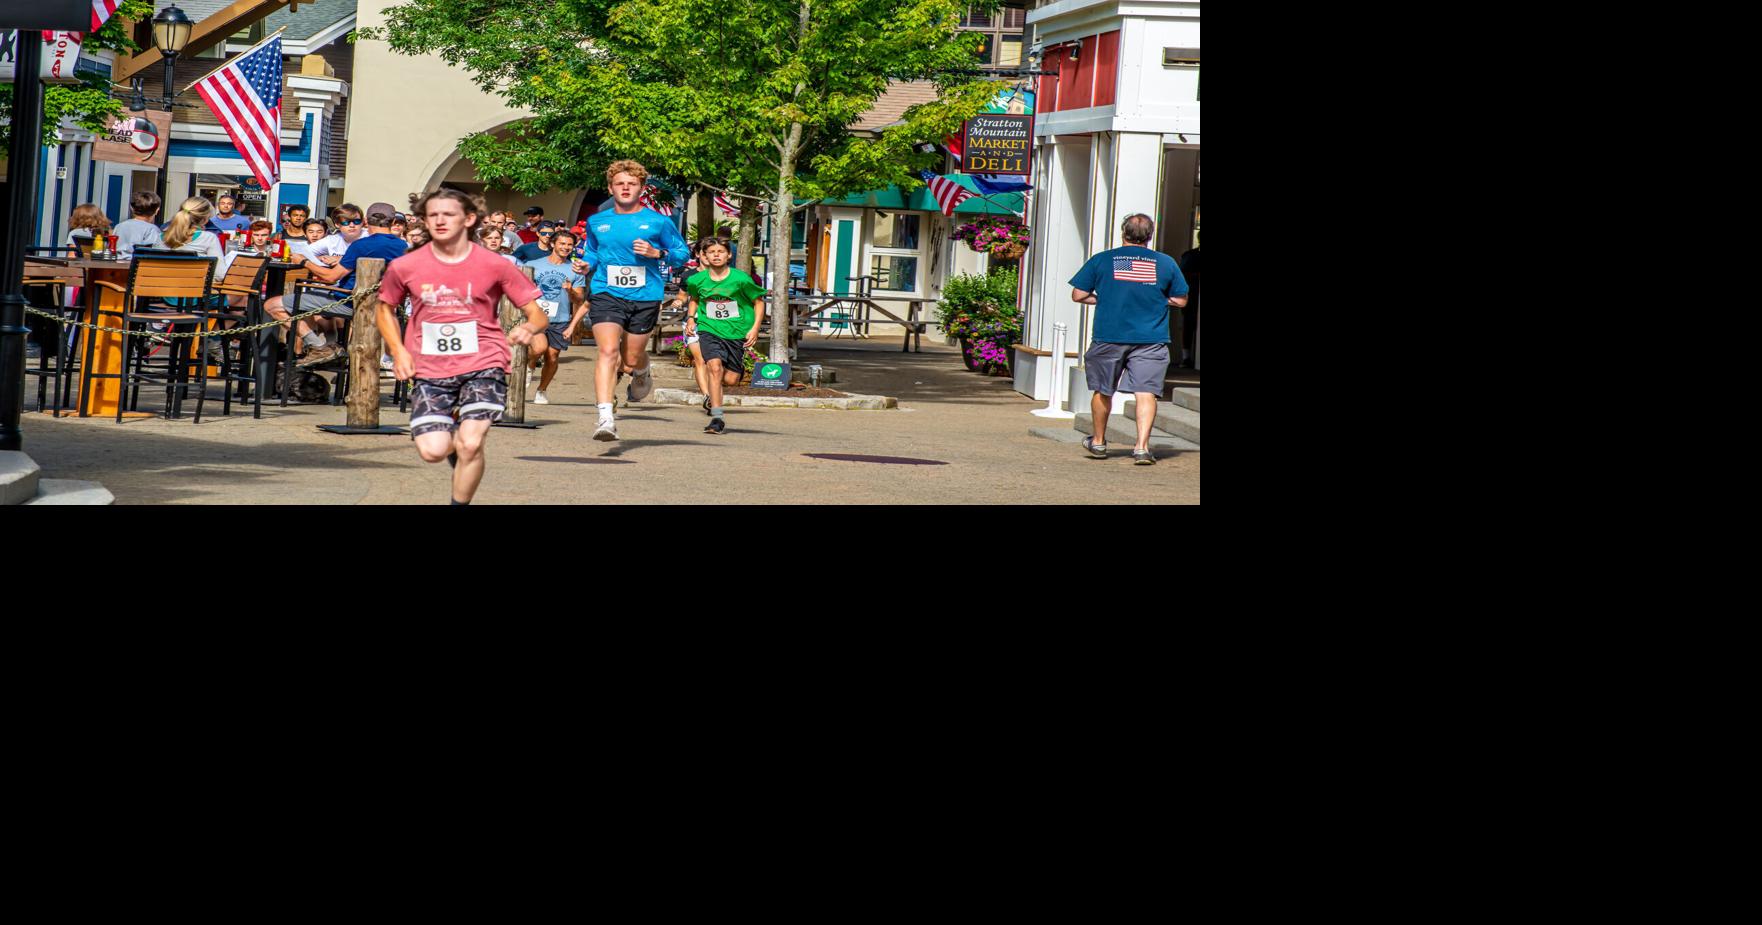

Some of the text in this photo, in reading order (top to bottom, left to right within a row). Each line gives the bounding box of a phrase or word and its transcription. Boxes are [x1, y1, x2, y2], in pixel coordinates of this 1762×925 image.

[974, 118, 1023, 127] Stratton
[969, 128, 1027, 137] Mountain
[969, 137, 1028, 149] MARKET
[970, 157, 1023, 171] DELI
[614, 275, 637, 286] 105
[715, 310, 730, 318] 83
[437, 337, 462, 352] 88
